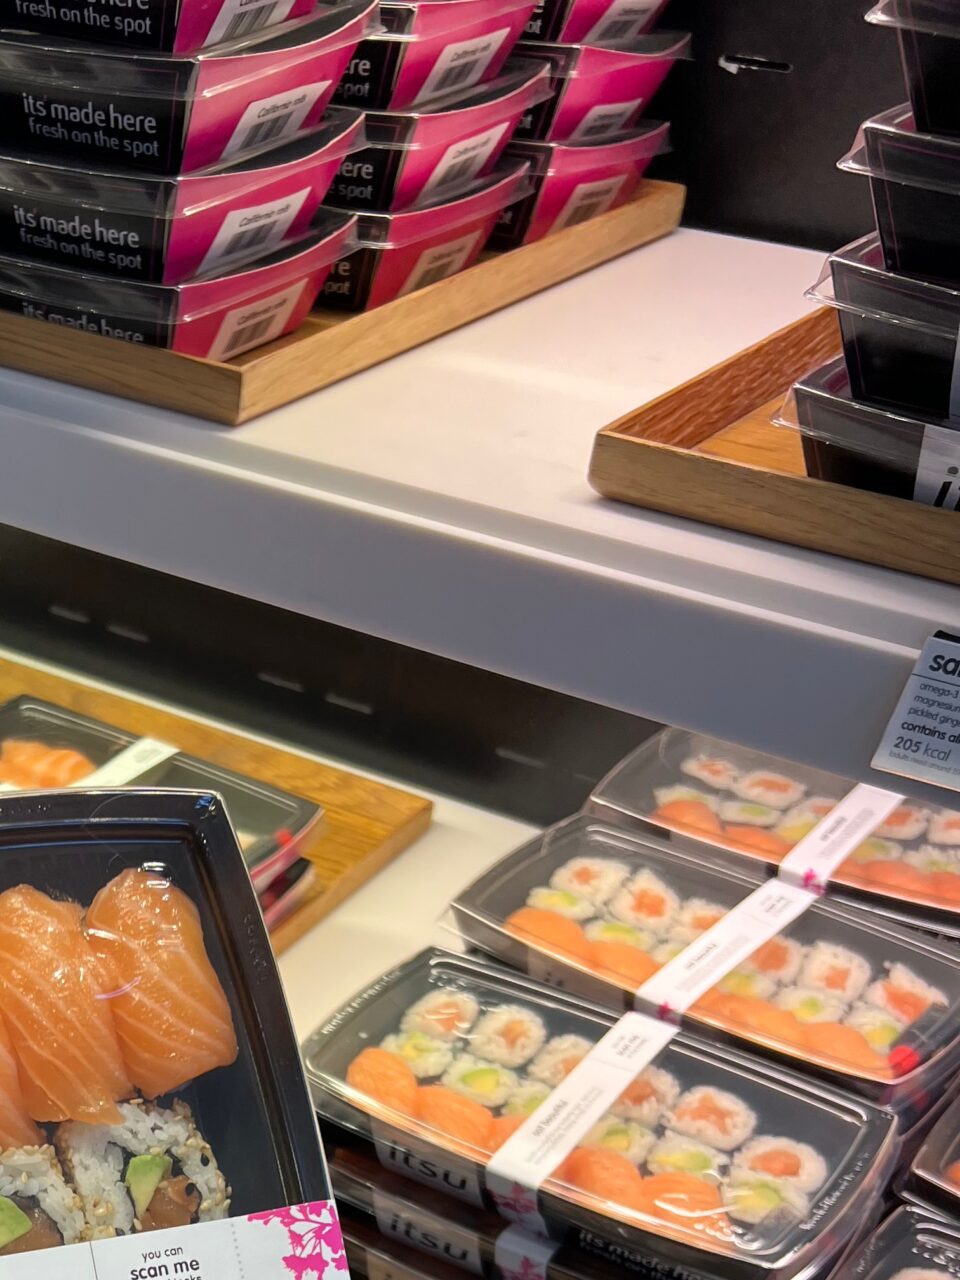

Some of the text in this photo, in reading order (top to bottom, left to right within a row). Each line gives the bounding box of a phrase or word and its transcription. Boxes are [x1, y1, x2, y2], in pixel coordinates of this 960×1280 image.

[16, 0, 152, 36] fresh on the spot
[50, 101, 107, 127] made
[109, 104, 157, 134] here
[29, 117, 160, 158] fresh on the spot
[20, 228, 143, 270] fresh on the spot
[40, 215, 92, 240] made
[94, 219, 140, 249] here
[901, 721, 947, 740] contains
[893, 736, 952, 761] 205 kcal
[390, 1141, 467, 1190] itsu
[391, 1213, 468, 1262] itsu
[130, 1259, 200, 1280] scan me
[141, 1247, 184, 1263] you can
